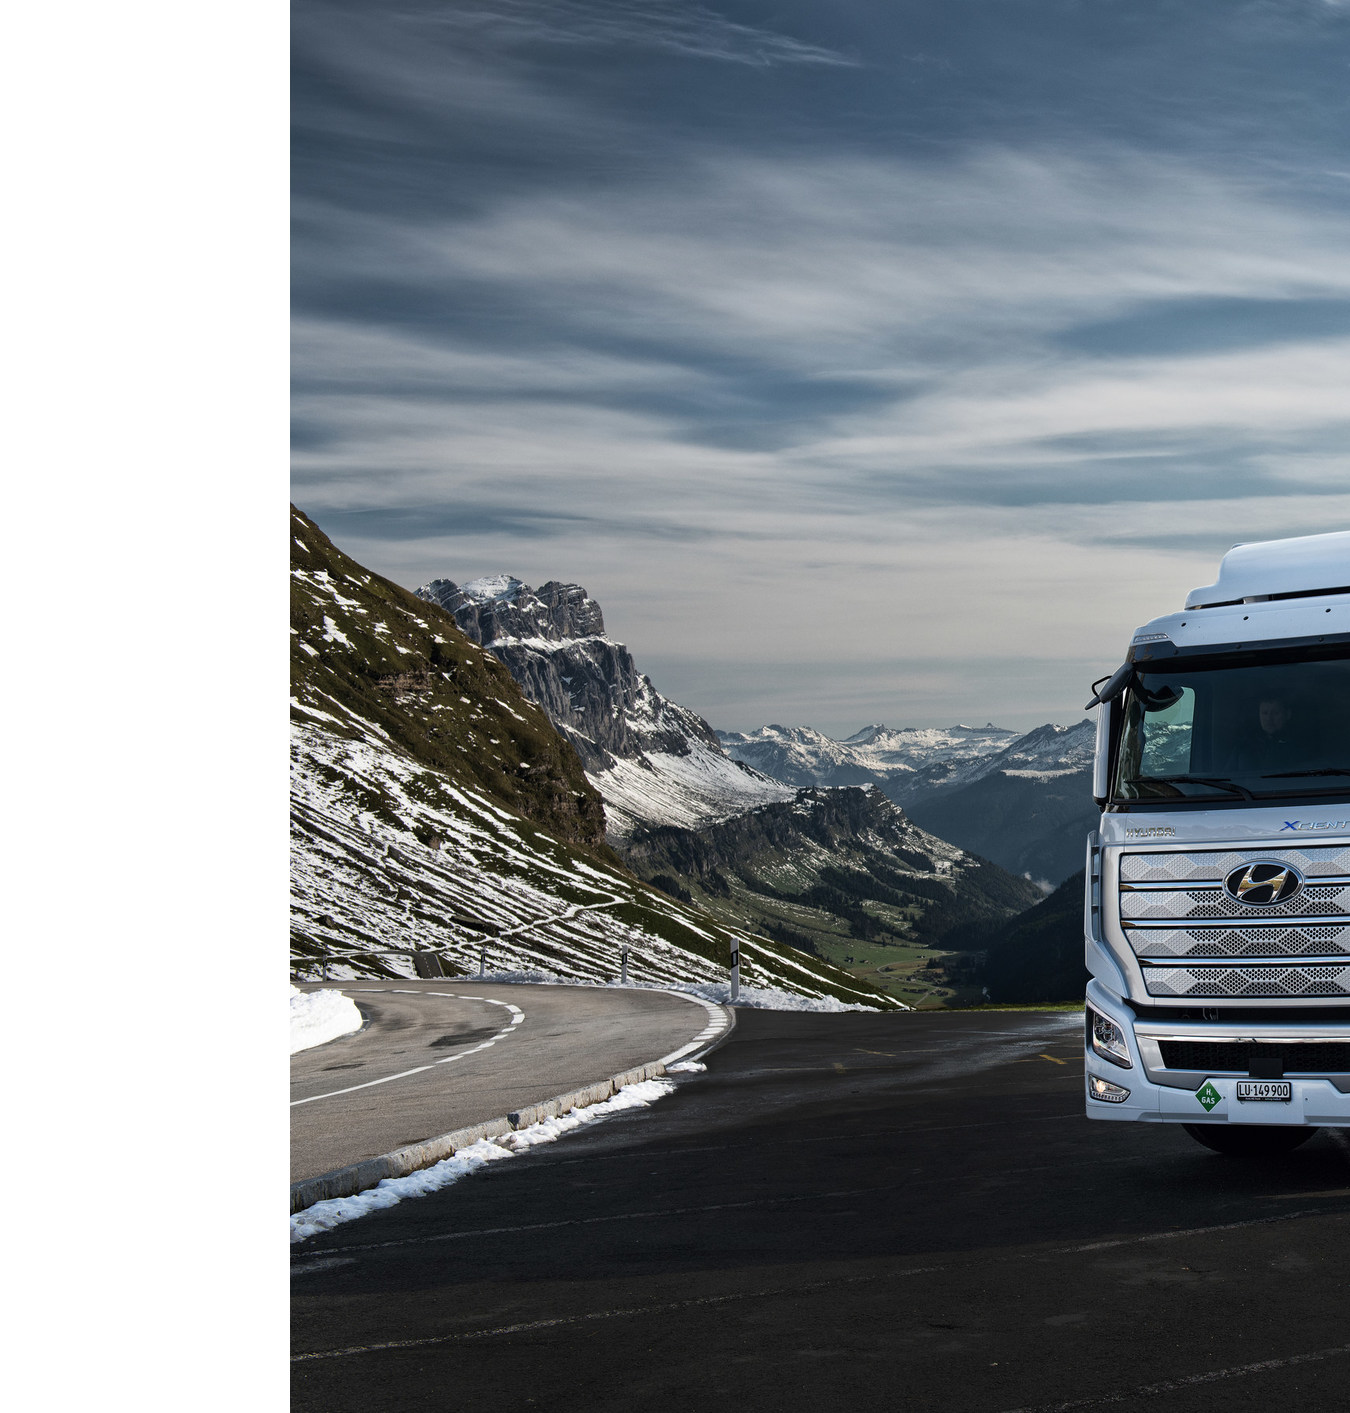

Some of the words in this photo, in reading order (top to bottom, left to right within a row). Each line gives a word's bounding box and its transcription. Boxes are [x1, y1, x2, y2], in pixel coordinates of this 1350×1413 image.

[1280, 820, 1350, 831] XCIENT
[1126, 826, 1176, 837] HYUNDAI
[1201, 1096, 1215, 1105] GAS
